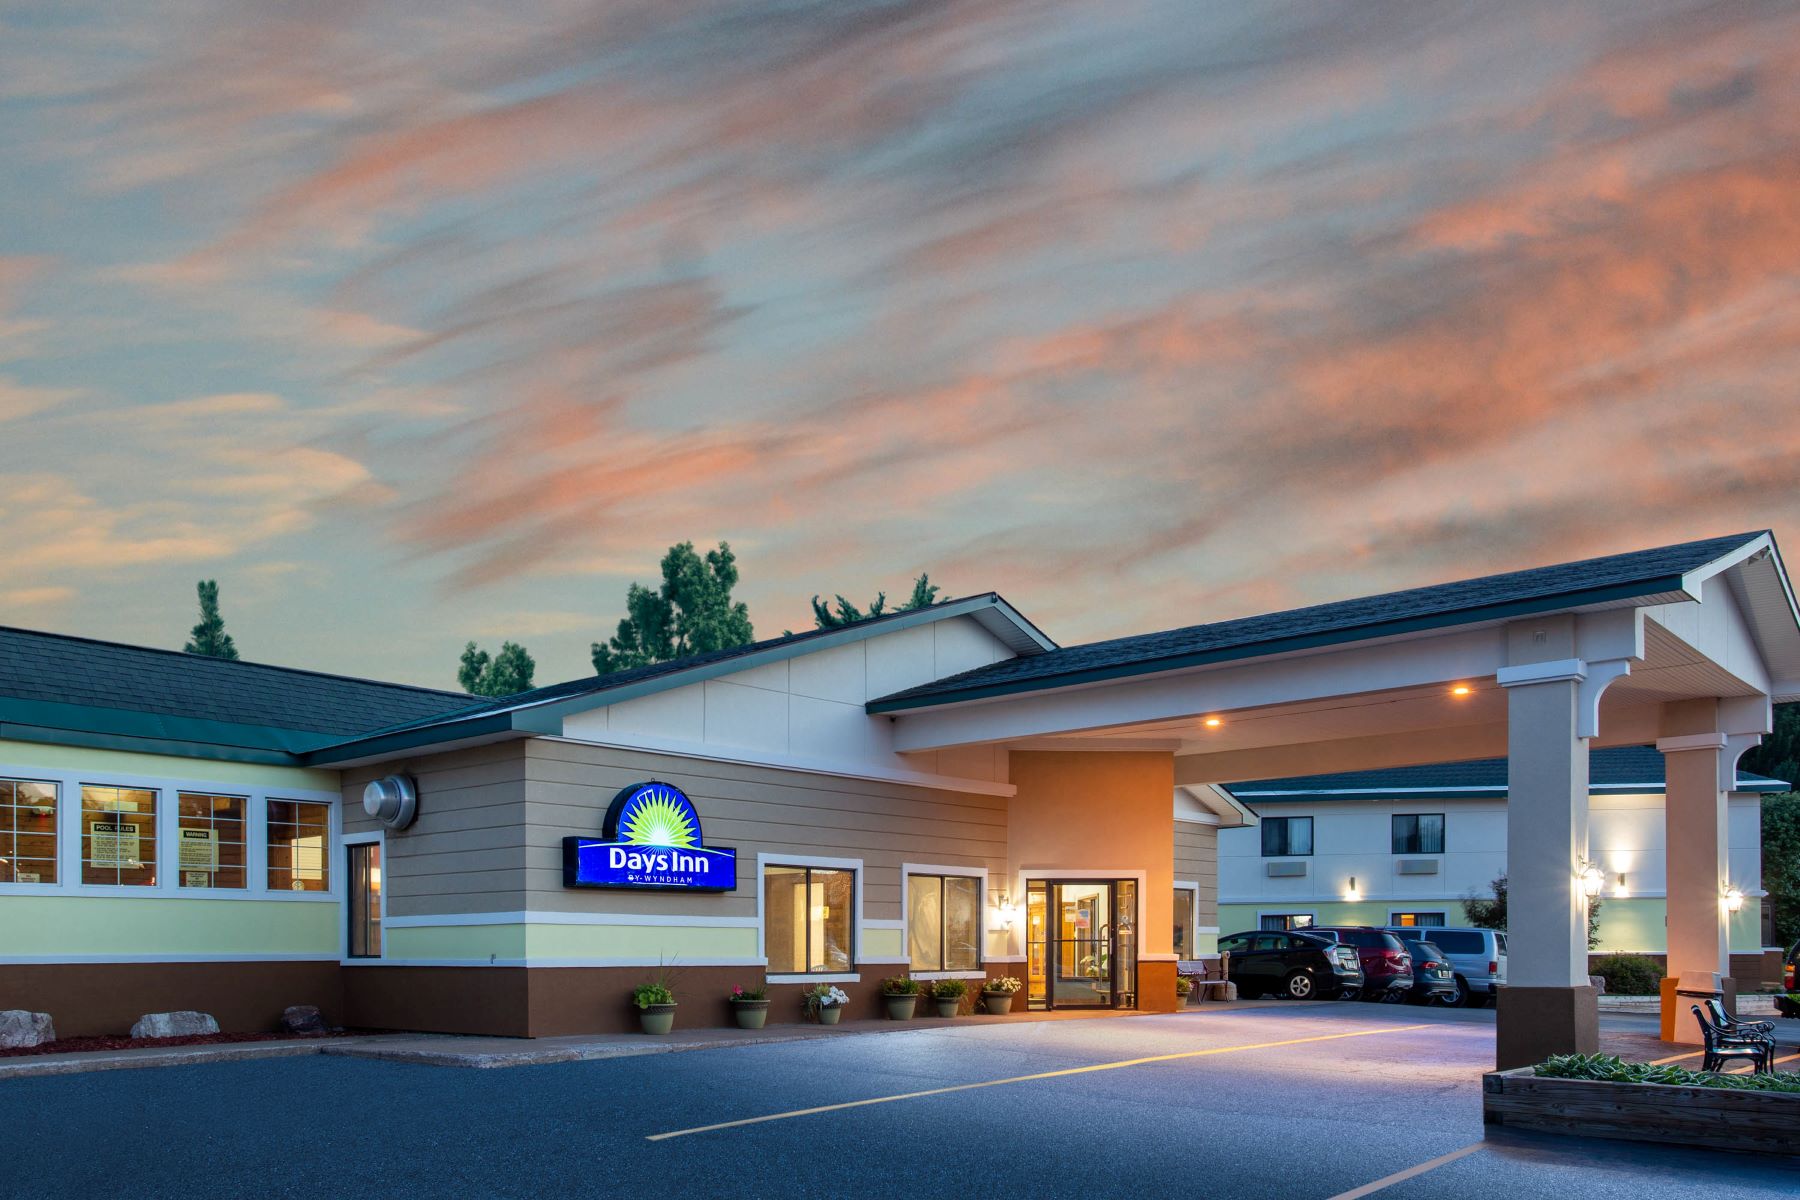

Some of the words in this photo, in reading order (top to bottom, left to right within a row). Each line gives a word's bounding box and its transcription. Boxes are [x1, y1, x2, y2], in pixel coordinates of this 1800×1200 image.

[609, 847, 668, 874] Days
[672, 851, 709, 873] Inn
[644, 875, 693, 884] WYNDHAM
